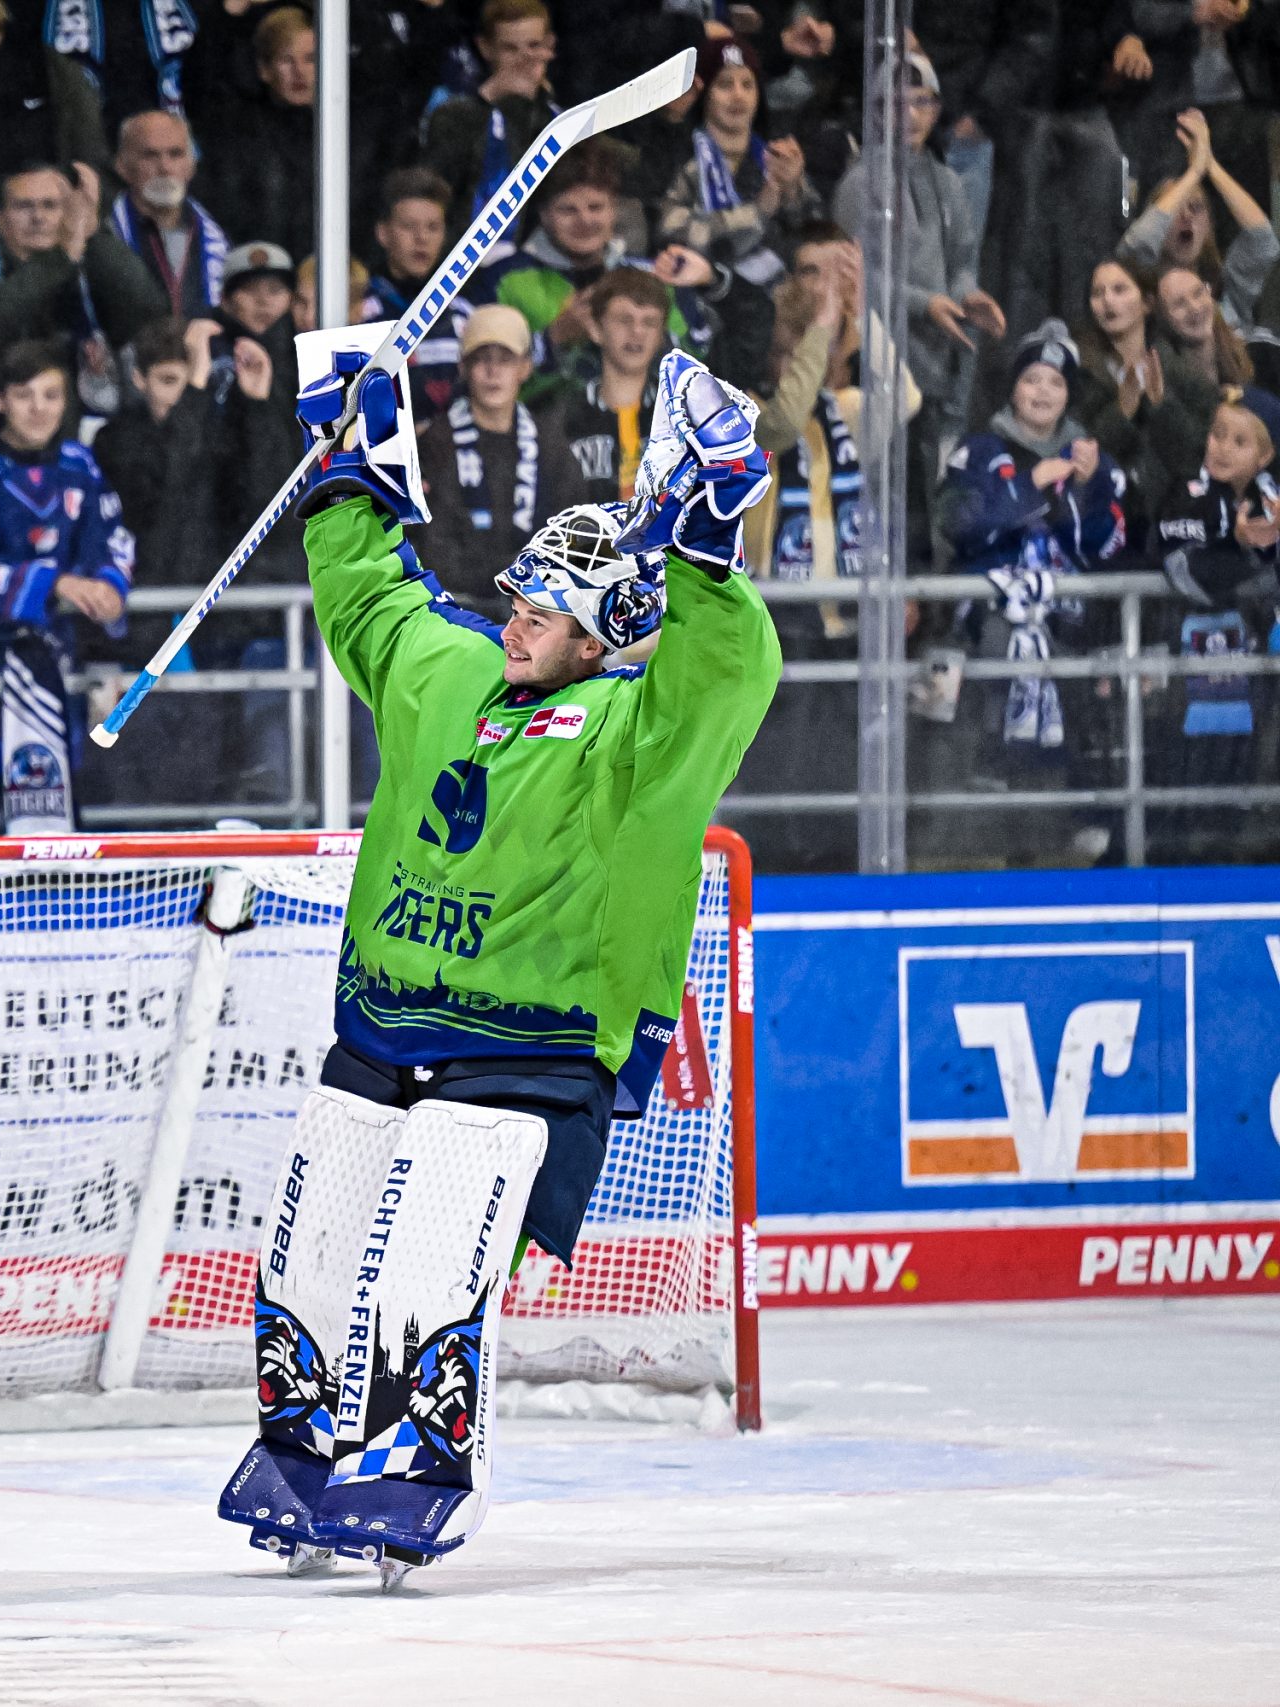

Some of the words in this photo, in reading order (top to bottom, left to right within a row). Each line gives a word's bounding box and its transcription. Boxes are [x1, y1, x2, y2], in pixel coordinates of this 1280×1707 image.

[393, 134, 562, 356] WARRIOR
[719, 416, 742, 434] MACH
[269, 1152, 309, 1277] BAUER
[466, 1175, 505, 1296] BAUER
[336, 1158, 412, 1433] RICHTER+FRENZEL
[476, 1342, 491, 1466] SUPREME
[232, 1456, 259, 1496] MACH
[423, 1498, 444, 1528] MACH
